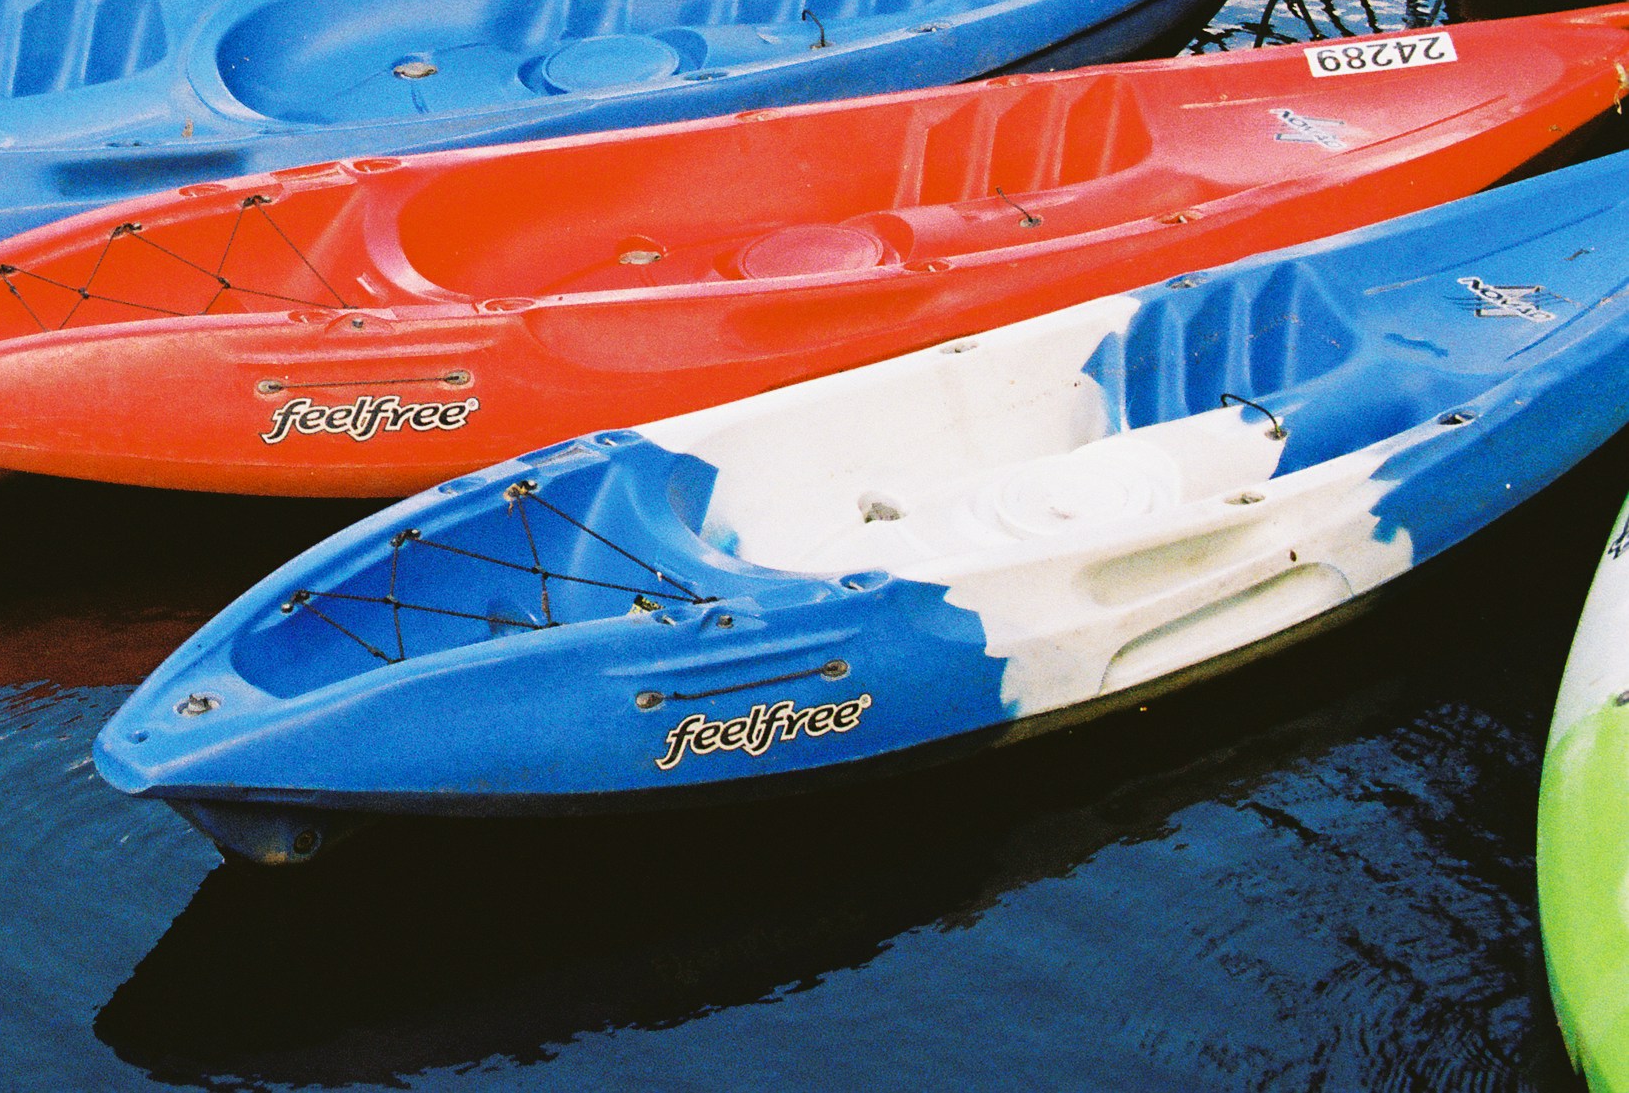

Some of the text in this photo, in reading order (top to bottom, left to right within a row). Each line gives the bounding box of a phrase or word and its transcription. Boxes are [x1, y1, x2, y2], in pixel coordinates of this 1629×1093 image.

[1317, 36, 1445, 72] 24289
[262, 397, 469, 441] feelfree
[658, 701, 863, 768] feelfree
